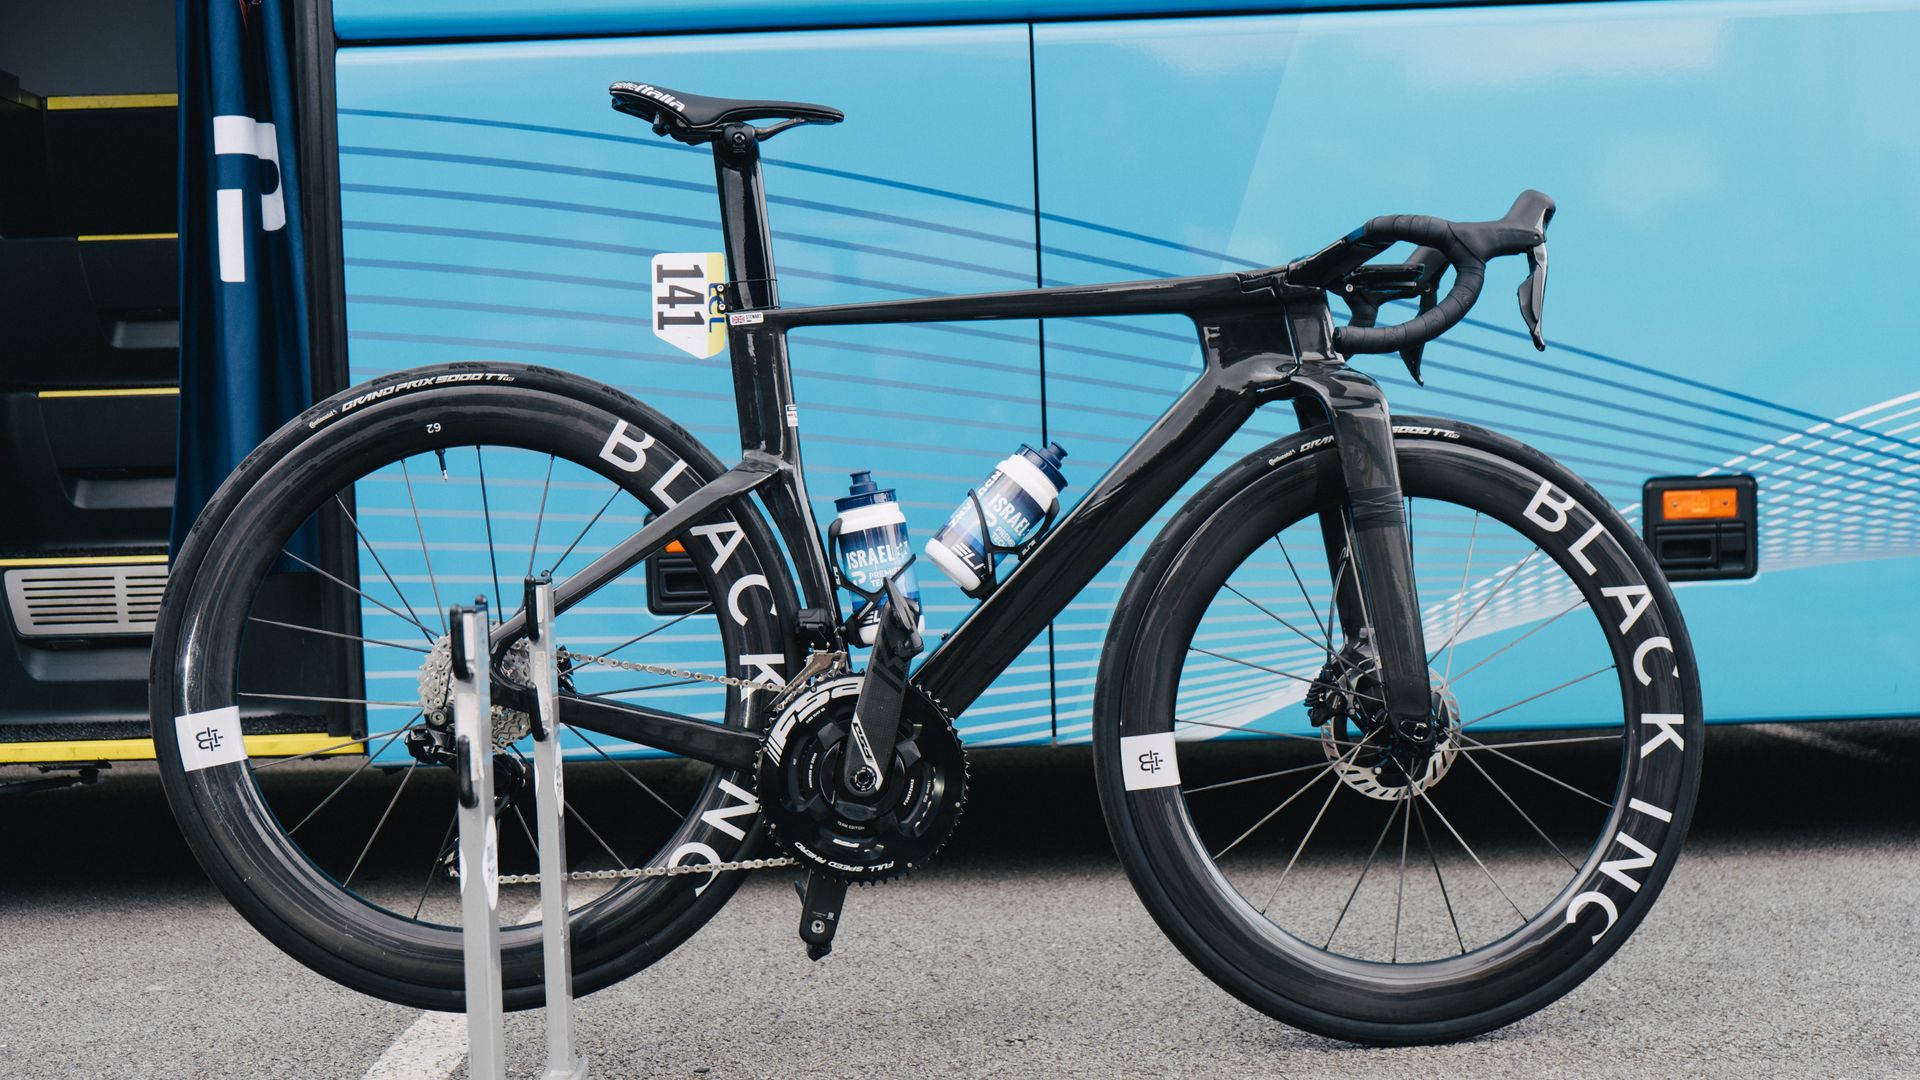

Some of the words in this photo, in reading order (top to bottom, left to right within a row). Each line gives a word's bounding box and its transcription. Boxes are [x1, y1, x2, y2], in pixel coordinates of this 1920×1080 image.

[656, 264, 705, 331] 141
[341, 385, 396, 413] GRAND
[395, 376, 435, 393] PRIX
[435, 373, 482, 384] 5000
[426, 422, 442, 434] 62
[599, 419, 787, 704] BLACK
[845, 543, 894, 570] ISRAEL
[1523, 480, 1685, 759] BLACK
[667, 778, 761, 898] NC
[794, 841, 827, 864] AHEAD
[828, 861, 864, 872] SPEED
[868, 860, 895, 873] FULL
[1566, 797, 1673, 945] INC
